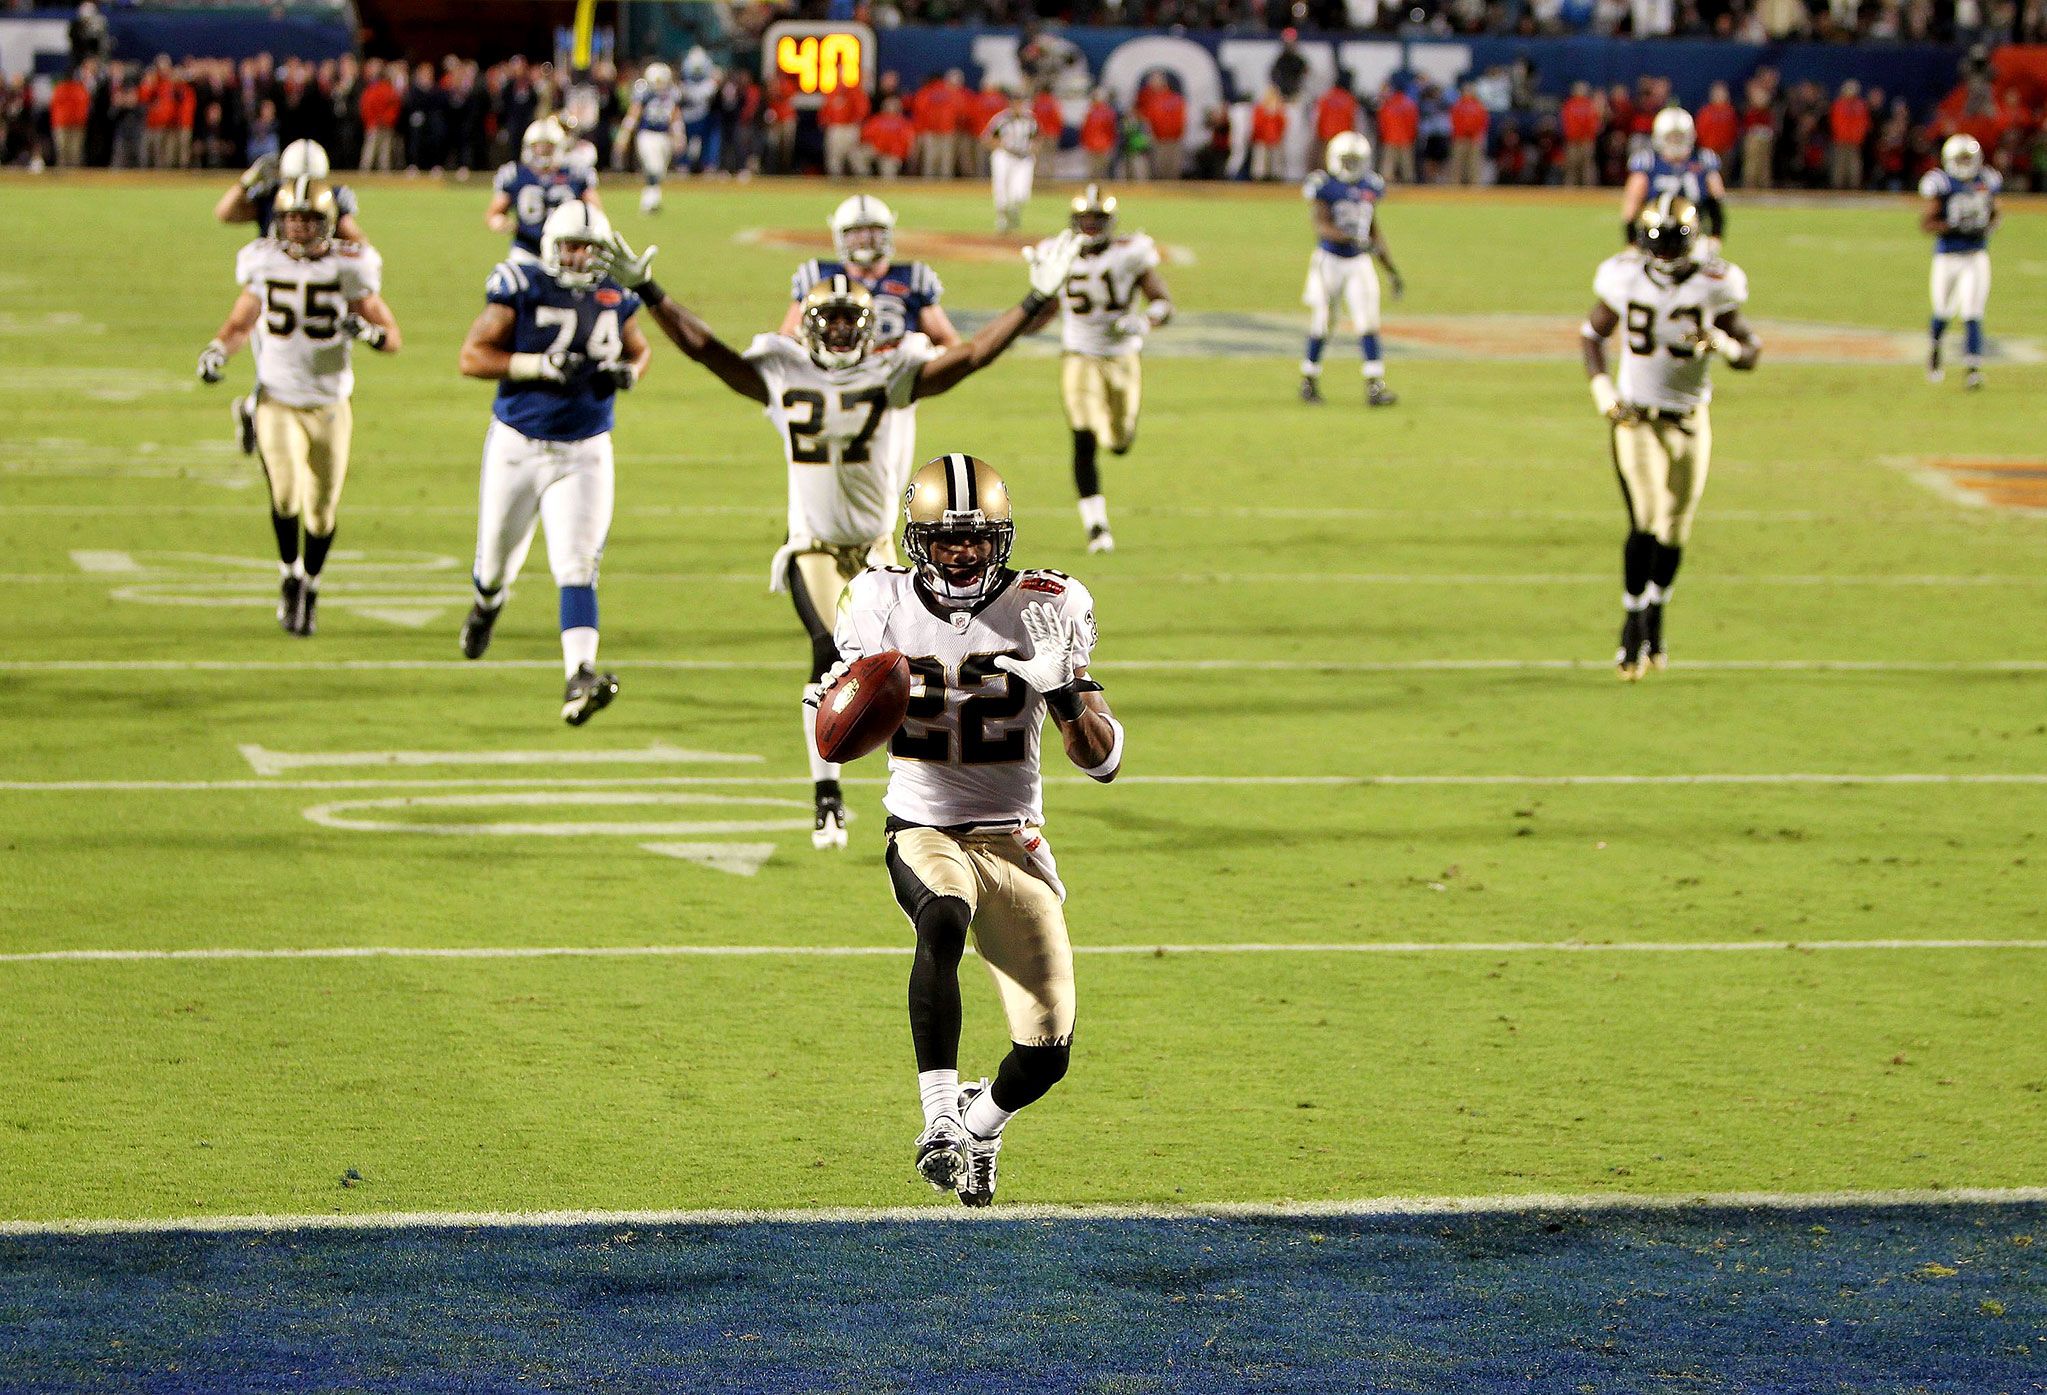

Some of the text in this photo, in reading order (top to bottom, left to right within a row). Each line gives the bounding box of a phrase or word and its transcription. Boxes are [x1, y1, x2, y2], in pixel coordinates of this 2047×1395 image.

[266, 279, 341, 339] 55
[1066, 270, 1128, 314] 51
[535, 305, 623, 361] 74
[782, 386, 888, 466] 27
[890, 649, 1027, 764] 22
